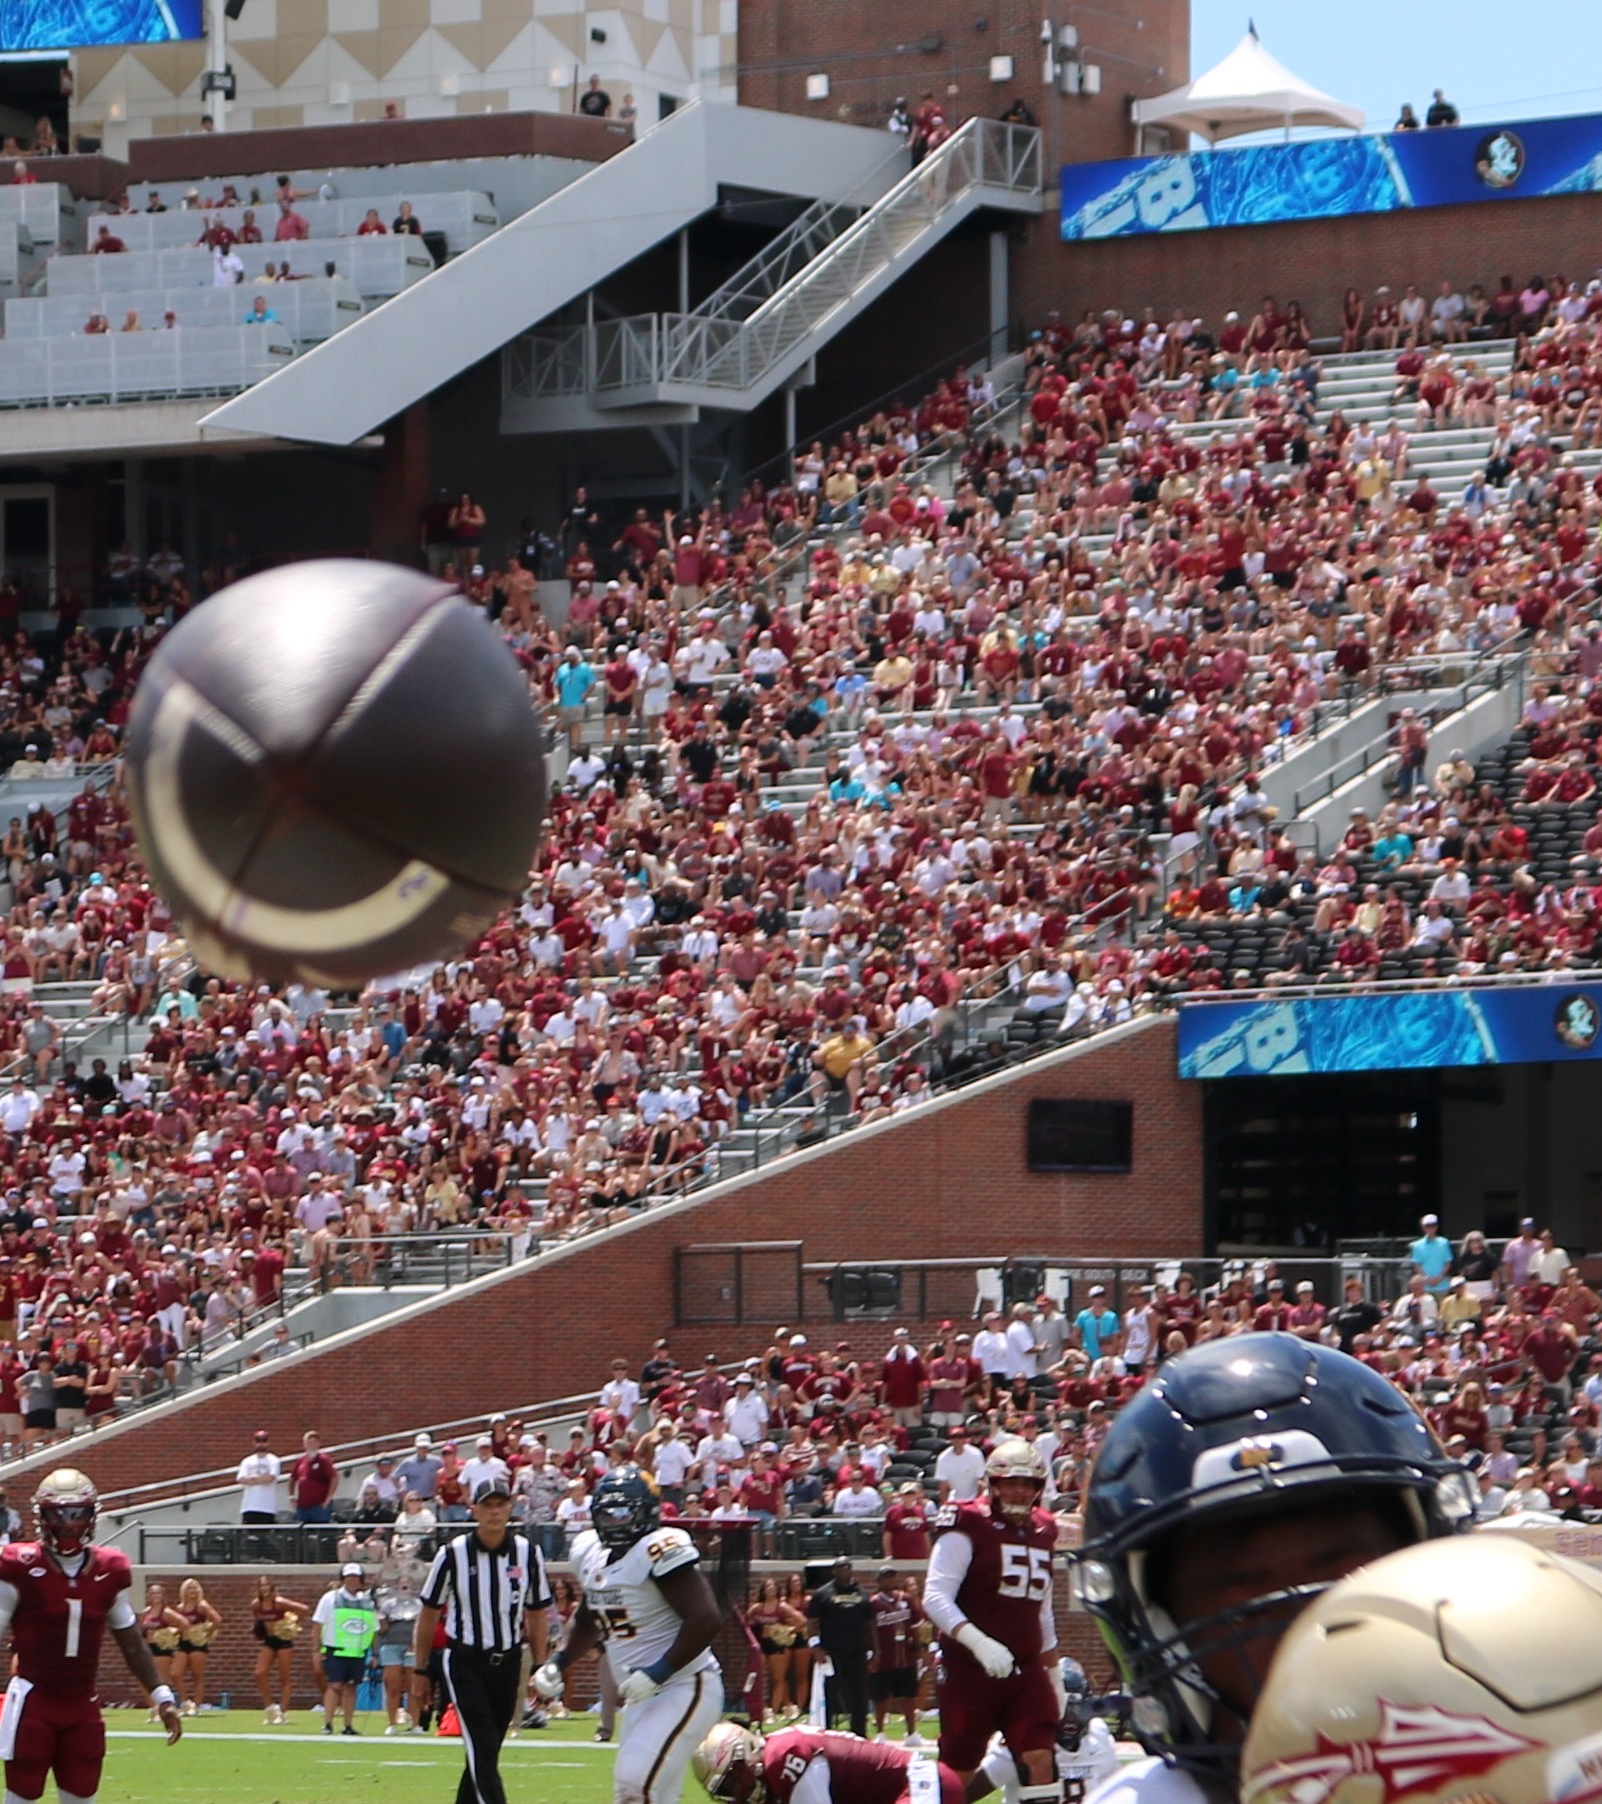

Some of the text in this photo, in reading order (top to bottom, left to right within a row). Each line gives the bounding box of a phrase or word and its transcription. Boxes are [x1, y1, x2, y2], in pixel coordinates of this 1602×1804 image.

[997, 1542, 1053, 1602] 55
[64, 1597, 84, 1658] 1
[779, 1753, 807, 1783] 76
